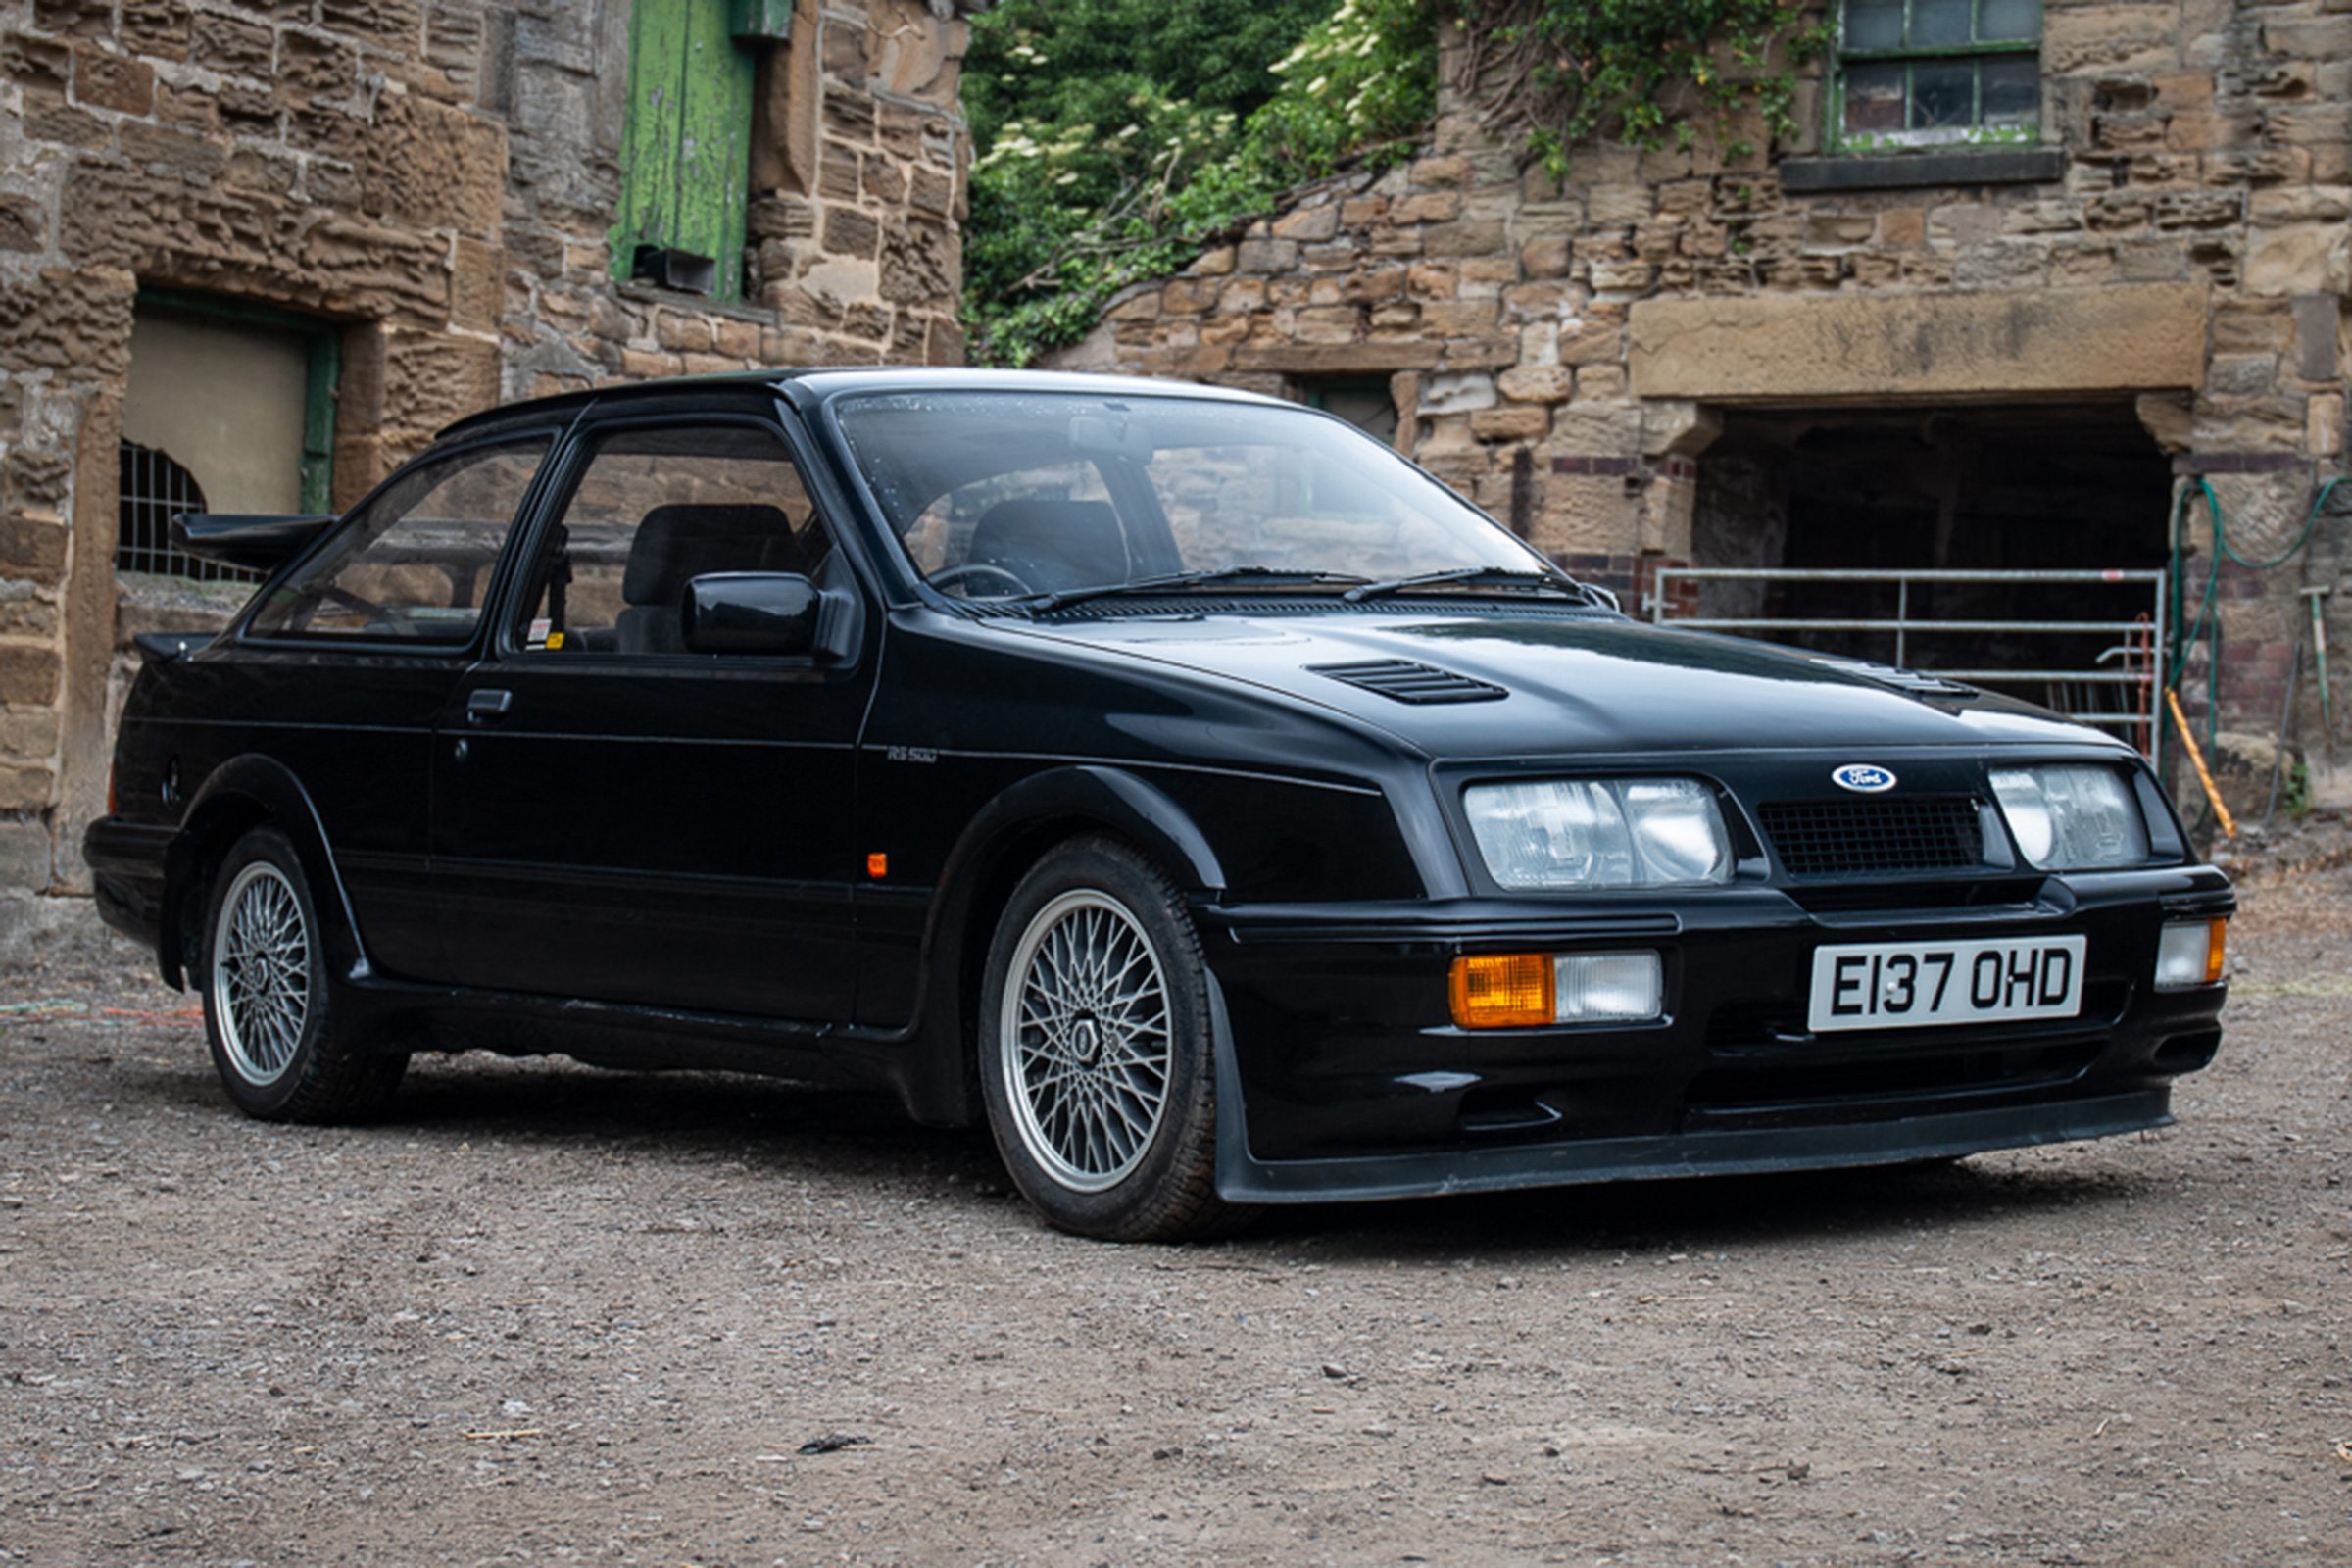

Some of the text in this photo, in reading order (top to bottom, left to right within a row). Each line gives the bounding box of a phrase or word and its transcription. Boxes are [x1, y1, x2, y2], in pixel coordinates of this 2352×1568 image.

[1848, 769, 1883, 786] Ford
[1831, 947, 2073, 1016] E137 OHD
